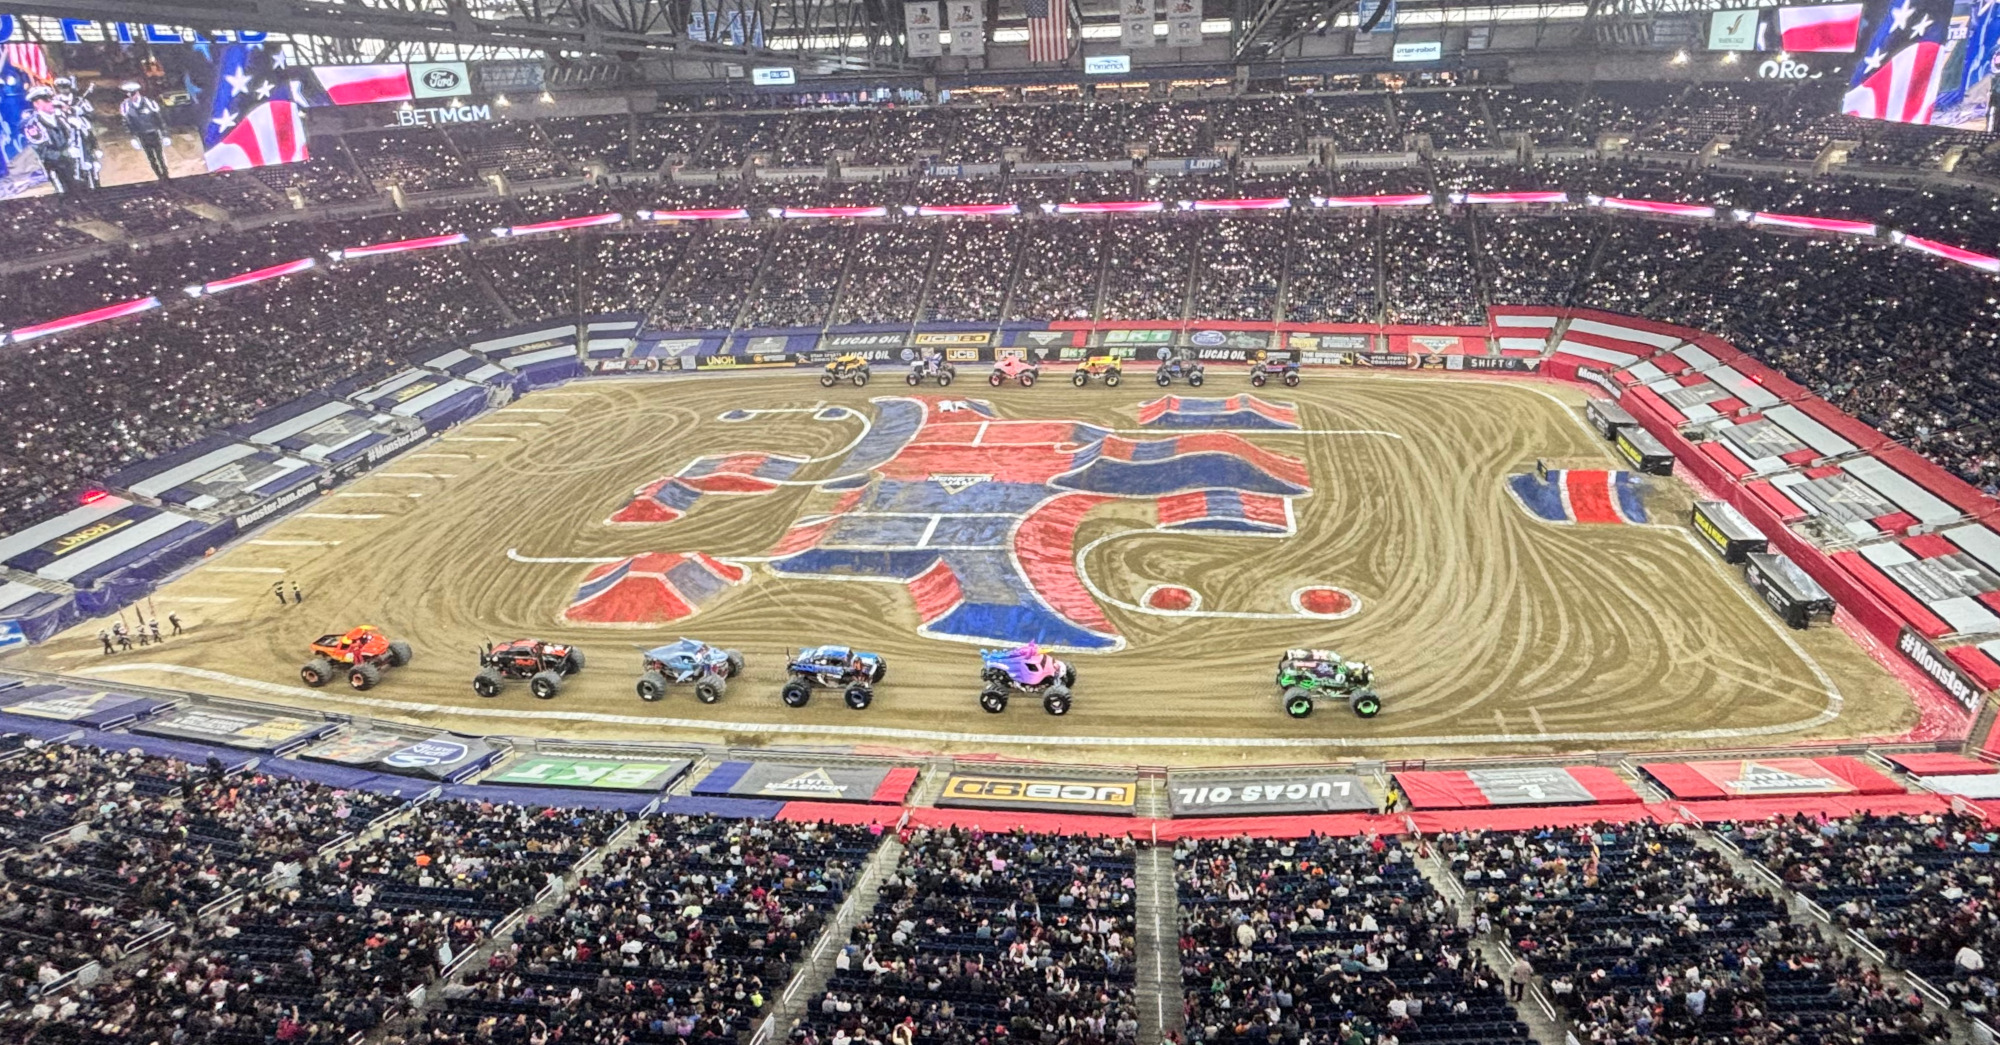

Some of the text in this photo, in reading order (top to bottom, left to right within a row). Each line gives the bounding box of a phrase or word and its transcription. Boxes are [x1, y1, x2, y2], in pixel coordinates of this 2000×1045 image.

[429, 71, 455, 87] Ford
[401, 104, 491, 126] BETMGM
[832, 335, 902, 345] LUCAS OIL
[707, 356, 735, 365] UNOH
[874, 350, 891, 360] OIL
[950, 349, 976, 359] JCB
[1199, 349, 1247, 360] LUCAS OIL
[1472, 359, 1504, 368] SHIFT
[368, 426, 427, 462] #MonsterJam
[236, 481, 317, 529] MonsterJam.com
[508, 763, 657, 783] BKT
[1026, 784, 1125, 801] JCB
[1178, 781, 1350, 804] LUCAS OIL
